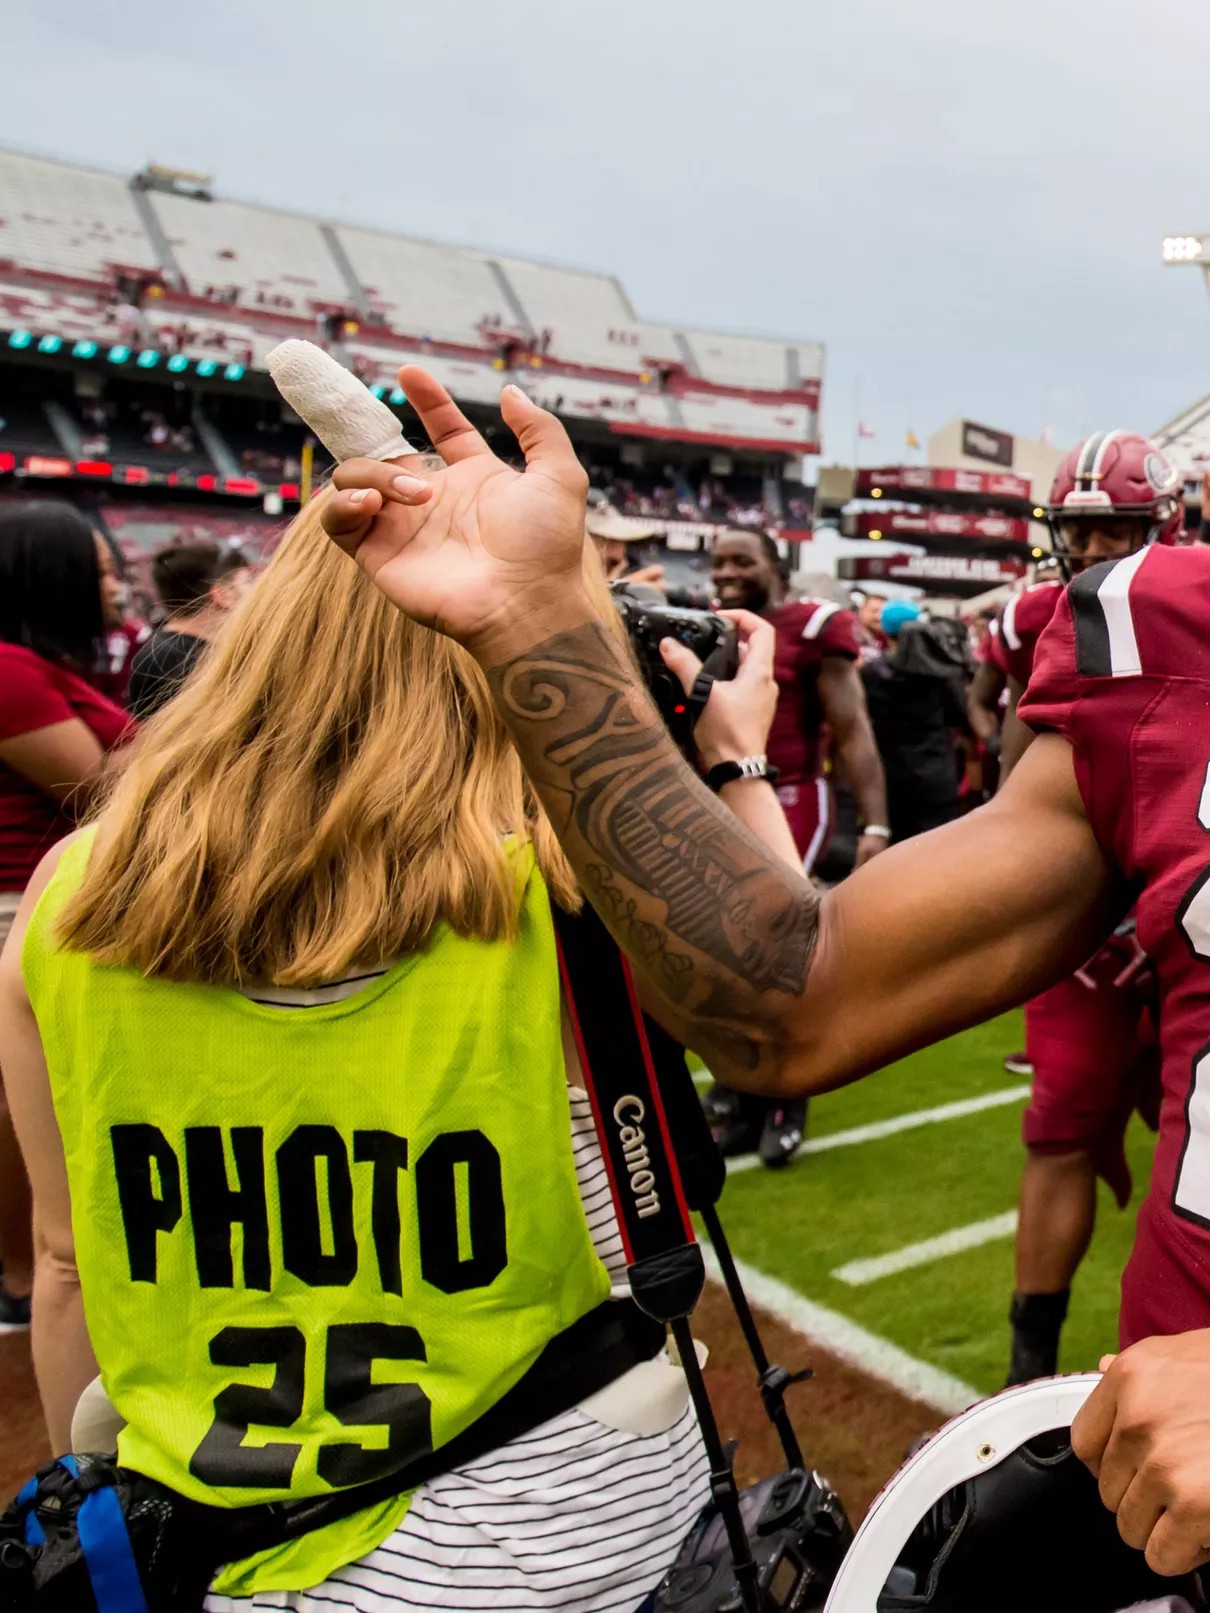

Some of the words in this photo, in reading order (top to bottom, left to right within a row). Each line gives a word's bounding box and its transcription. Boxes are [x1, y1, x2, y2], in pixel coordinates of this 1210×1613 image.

[110, 1122, 508, 1297] PHOTO
[612, 1094, 661, 1219] Canon
[188, 1322, 433, 1489] 25
